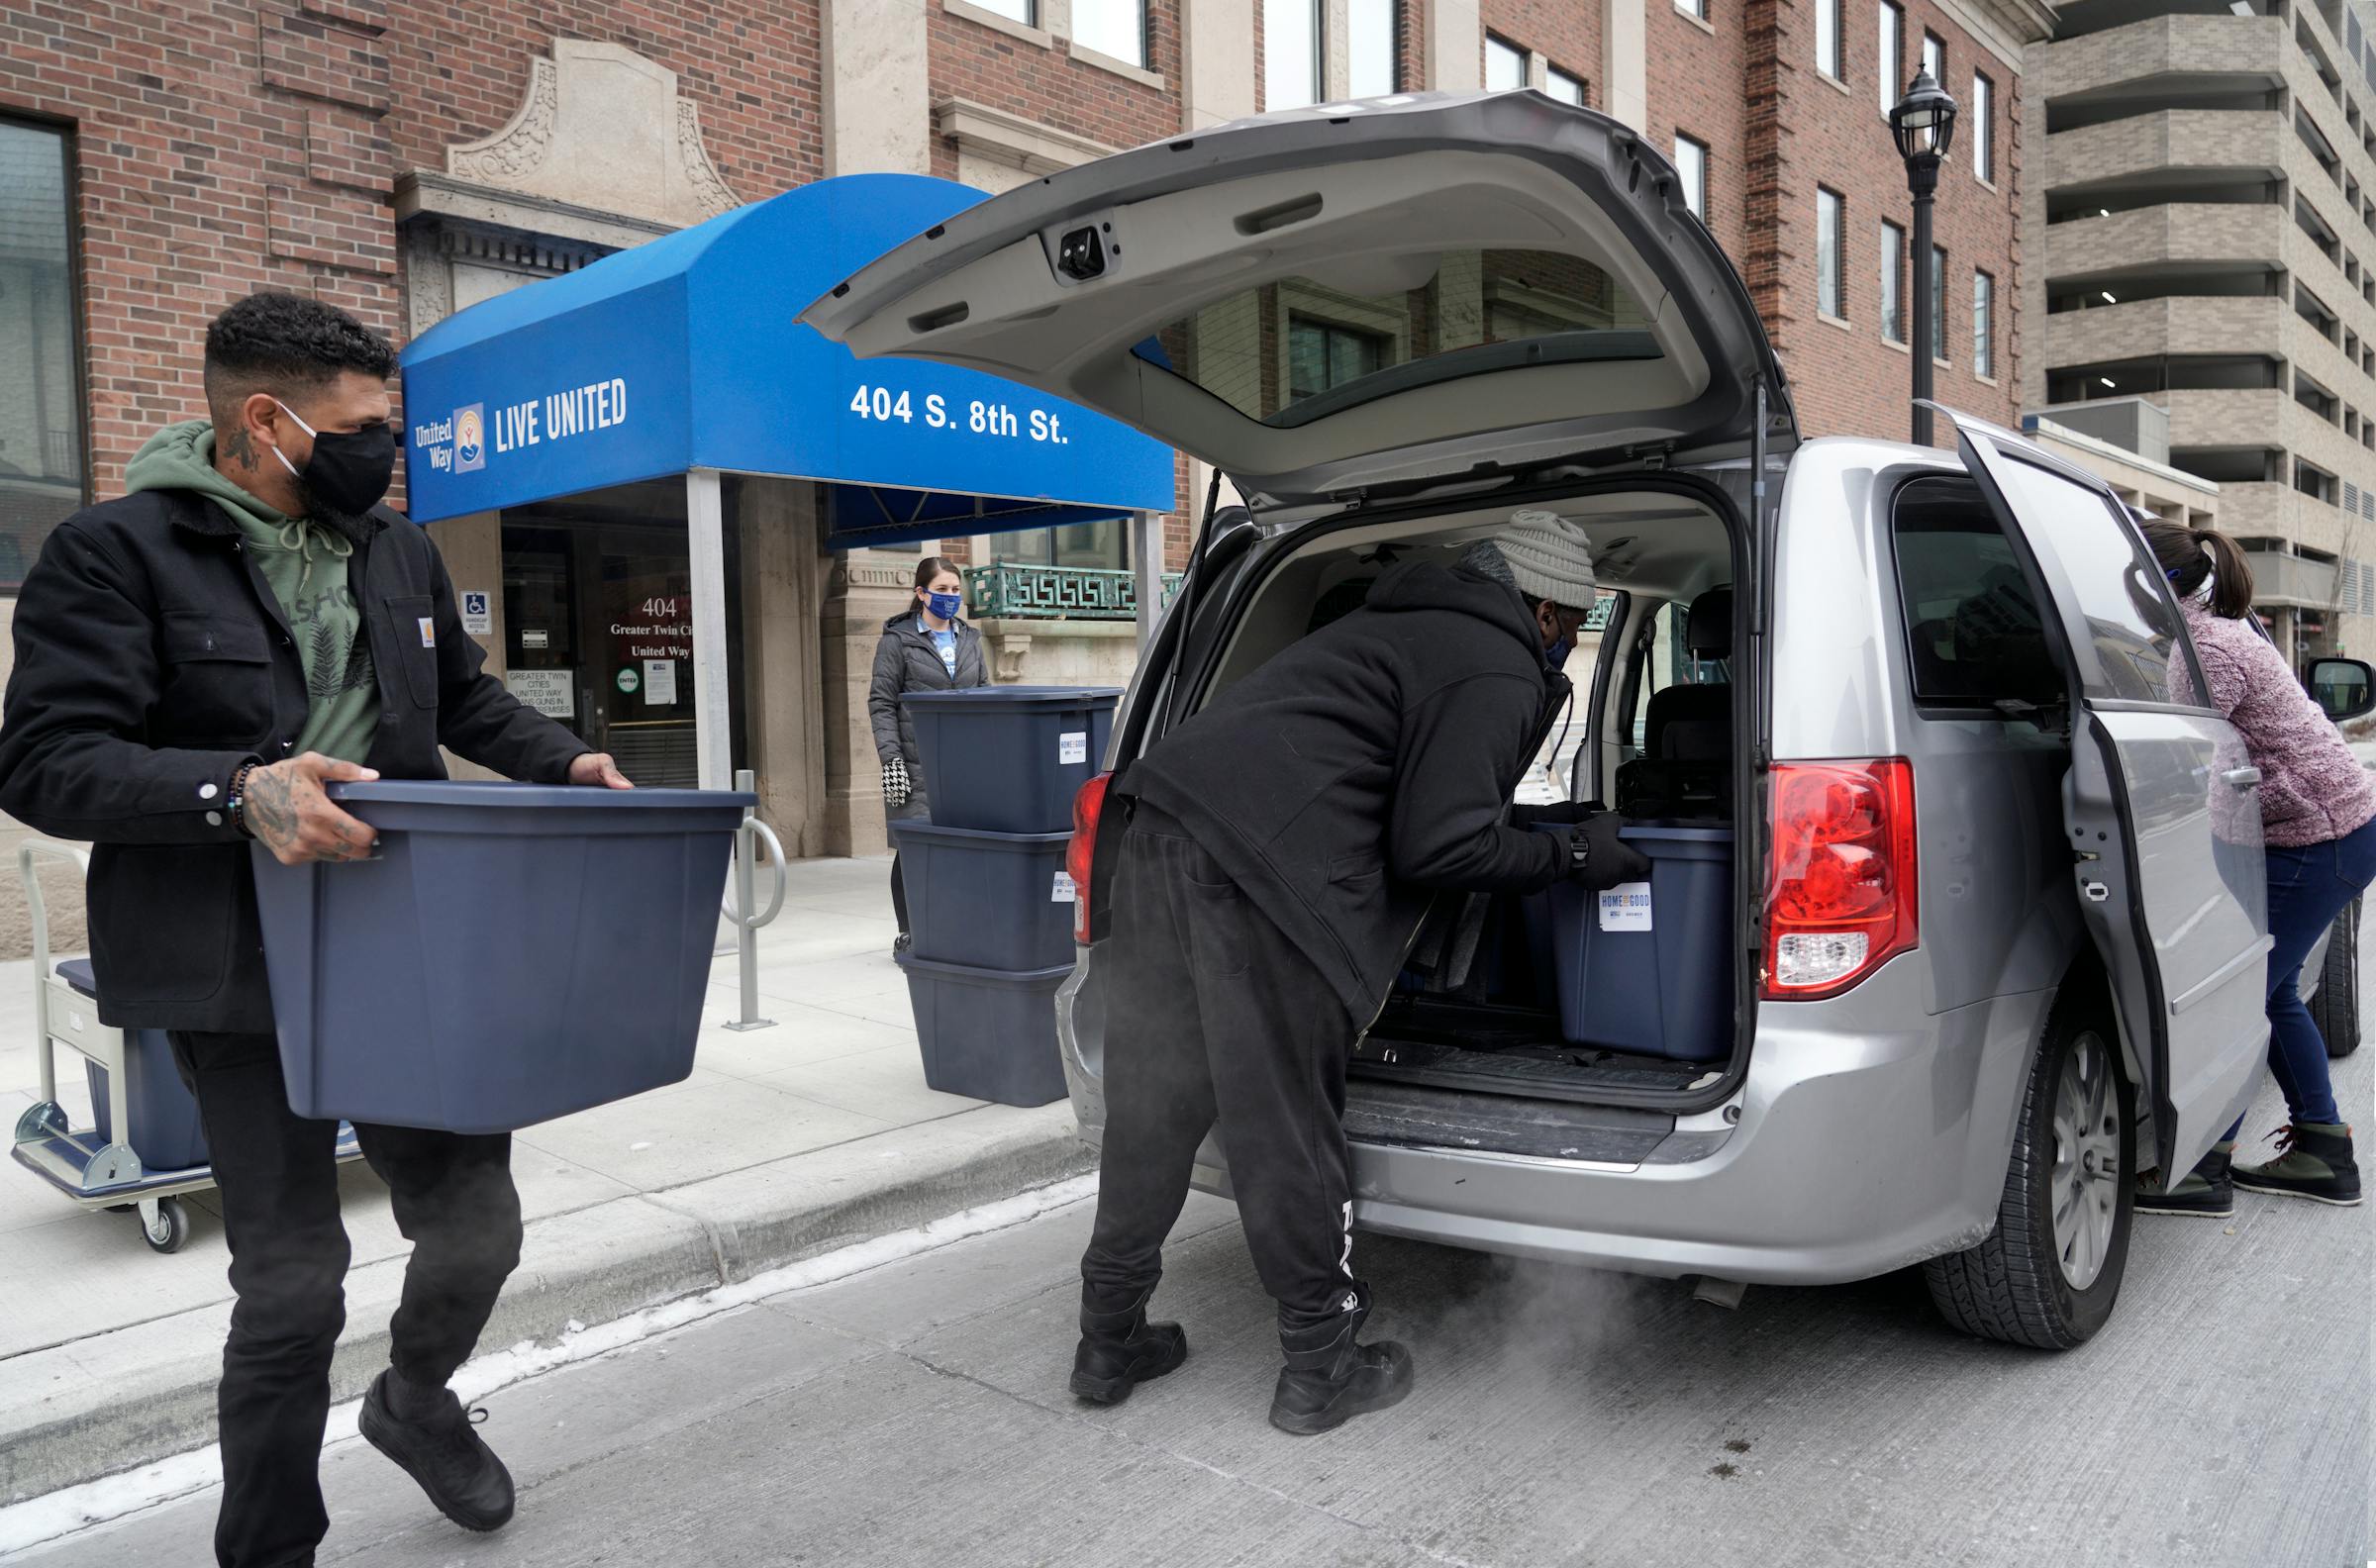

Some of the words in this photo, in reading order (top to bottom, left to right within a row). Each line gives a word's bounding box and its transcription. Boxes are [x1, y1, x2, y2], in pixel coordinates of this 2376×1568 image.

[496, 400, 541, 453] LIVE
[546, 377, 627, 441] UNITED
[849, 384, 913, 424] 404
[925, 394, 957, 430] S.
[968, 400, 1018, 438] 8th
[1029, 408, 1068, 444] St.
[415, 418, 453, 447] United
[429, 445, 453, 472] Way
[643, 597, 677, 618] 404
[610, 624, 651, 635] Greater
[652, 625, 678, 636] Twin
[632, 645, 665, 657] United
[668, 645, 690, 660] Way
[509, 672, 545, 681] GREATER
[548, 672, 567, 681] TWIN
[528, 680, 550, 689] CITIES
[1602, 895, 1623, 907] HOME
[1630, 894, 1649, 907] GOOD
